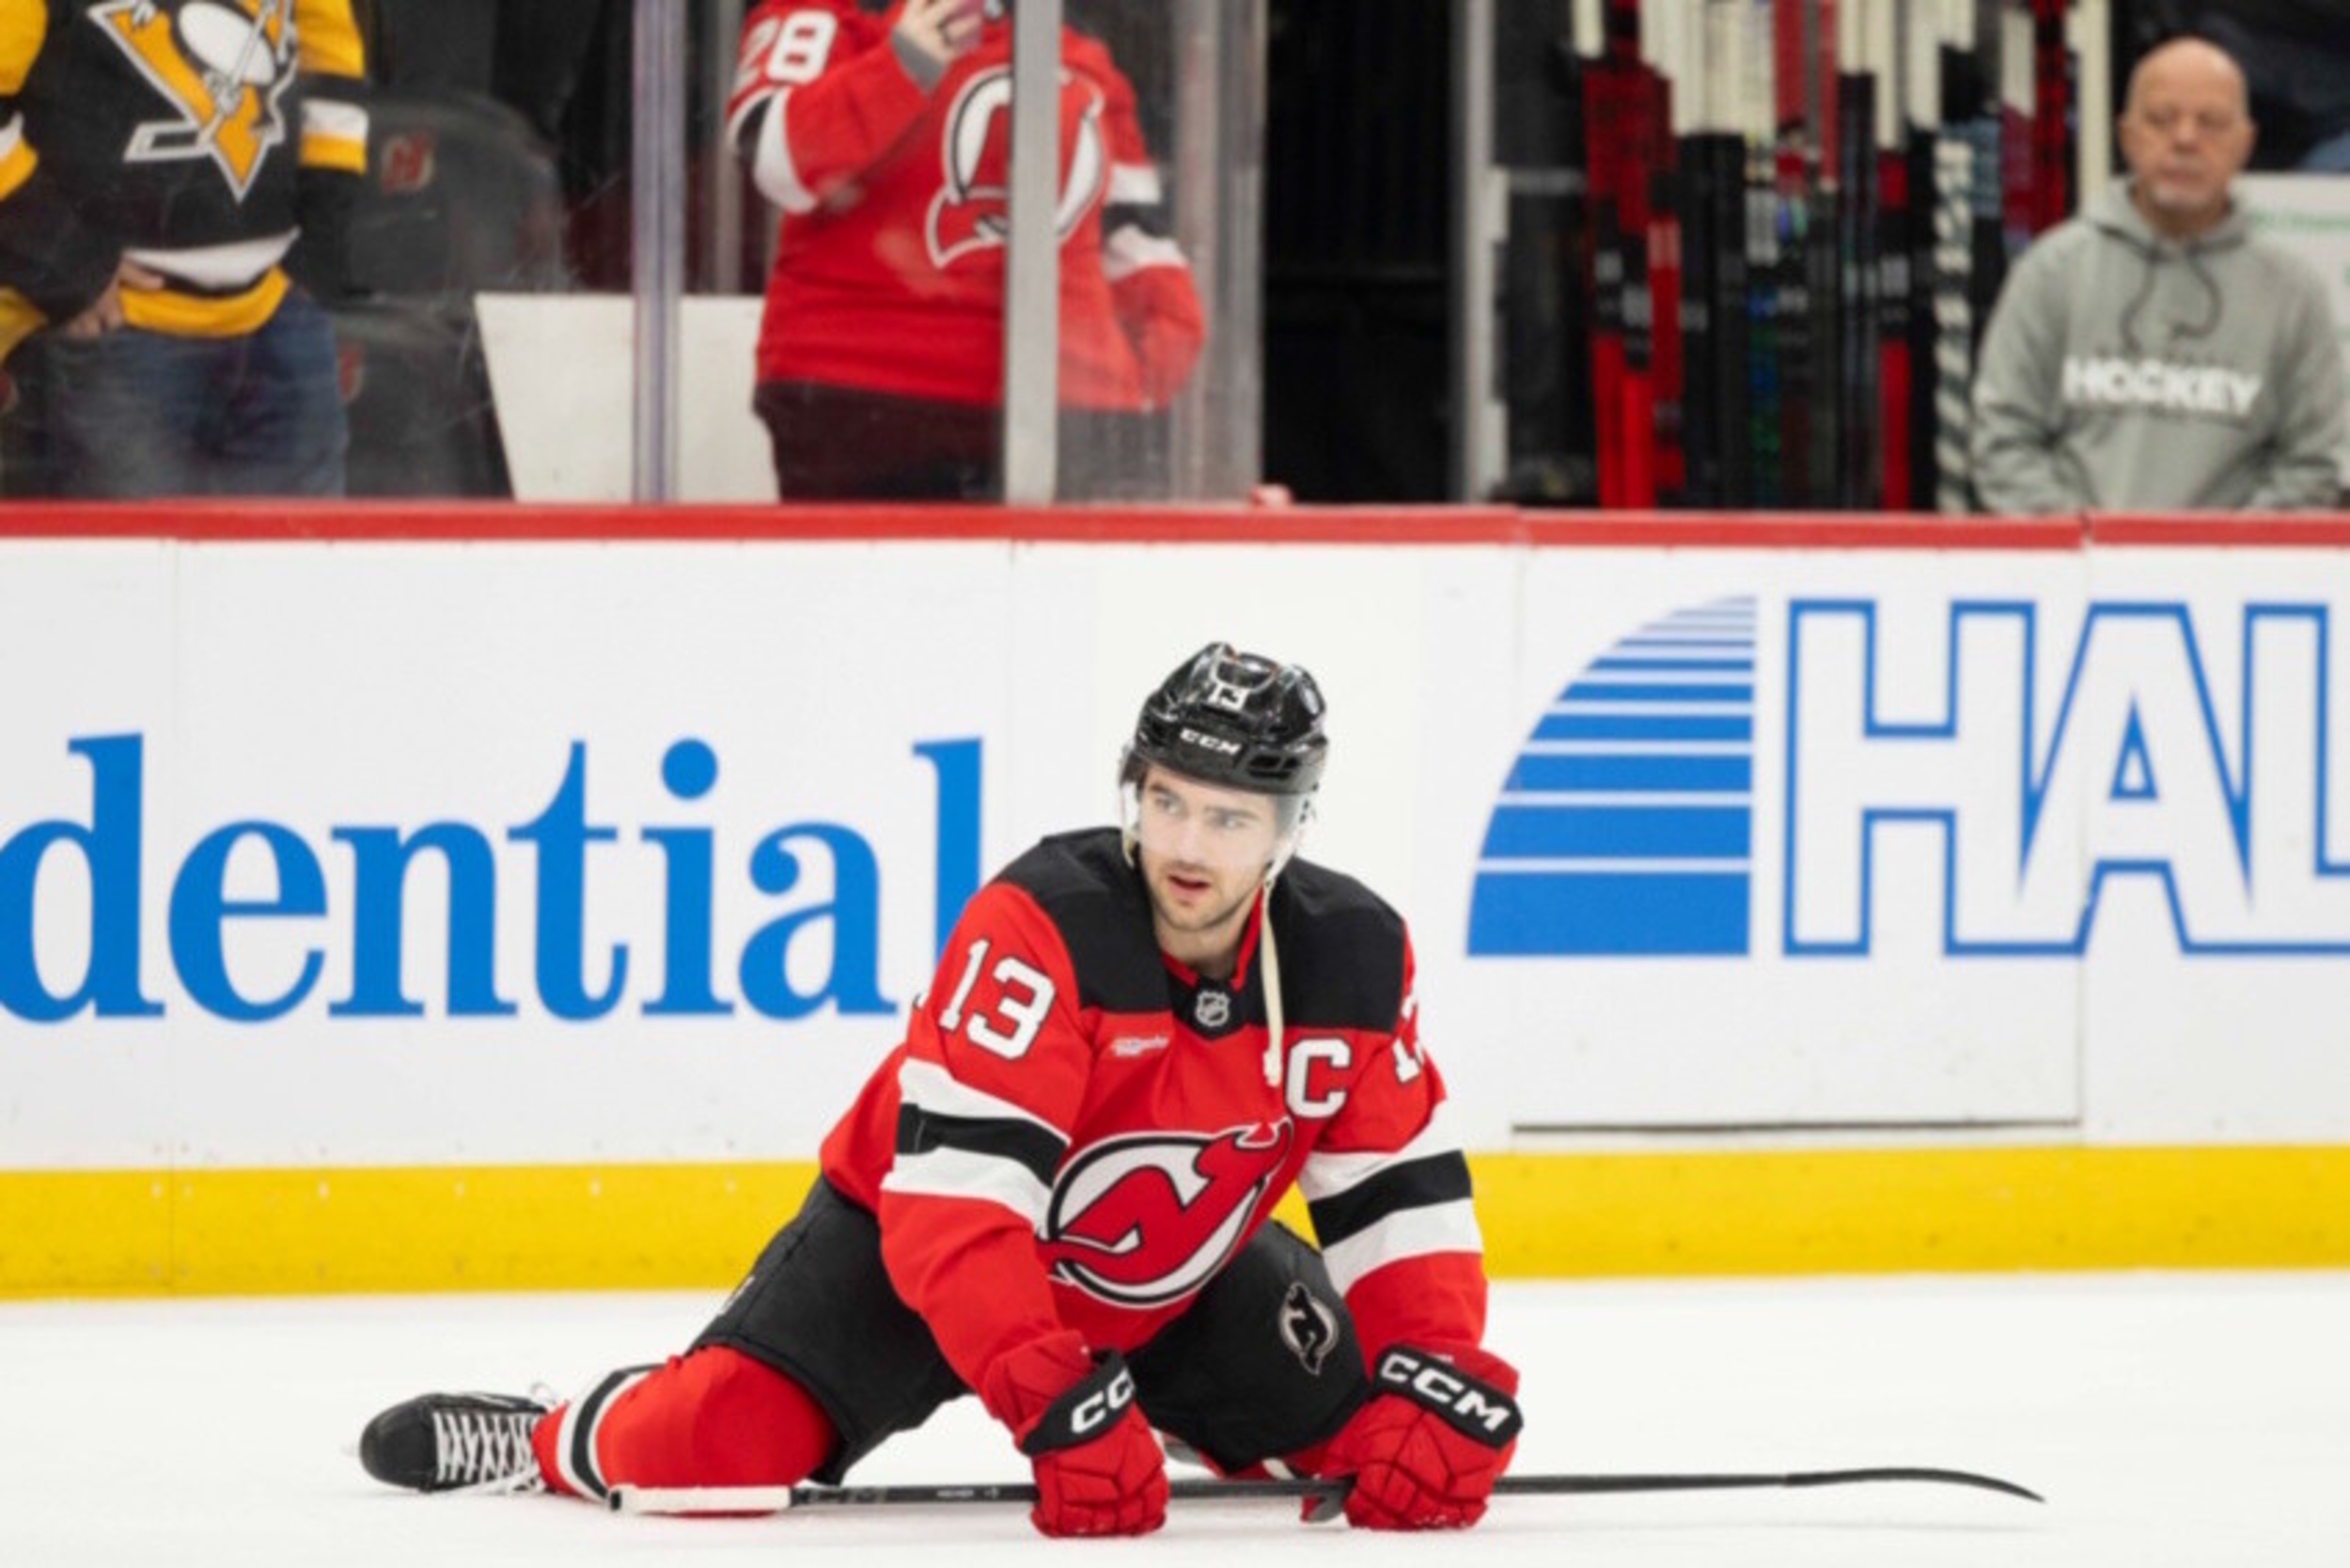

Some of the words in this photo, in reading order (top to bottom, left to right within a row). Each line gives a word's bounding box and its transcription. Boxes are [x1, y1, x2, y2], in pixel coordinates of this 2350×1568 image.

[736, 10, 837, 85] 28
[2063, 357, 2262, 414] HOCKEY
[1208, 682, 1250, 712] 13
[1180, 729, 1241, 755] CCM
[1783, 599, 2350, 957] HAL
[0, 734, 983, 1023] dential
[938, 938, 1056, 1060] 13
[1286, 1039, 1351, 1119] C
[1381, 1353, 1511, 1432] CCM
